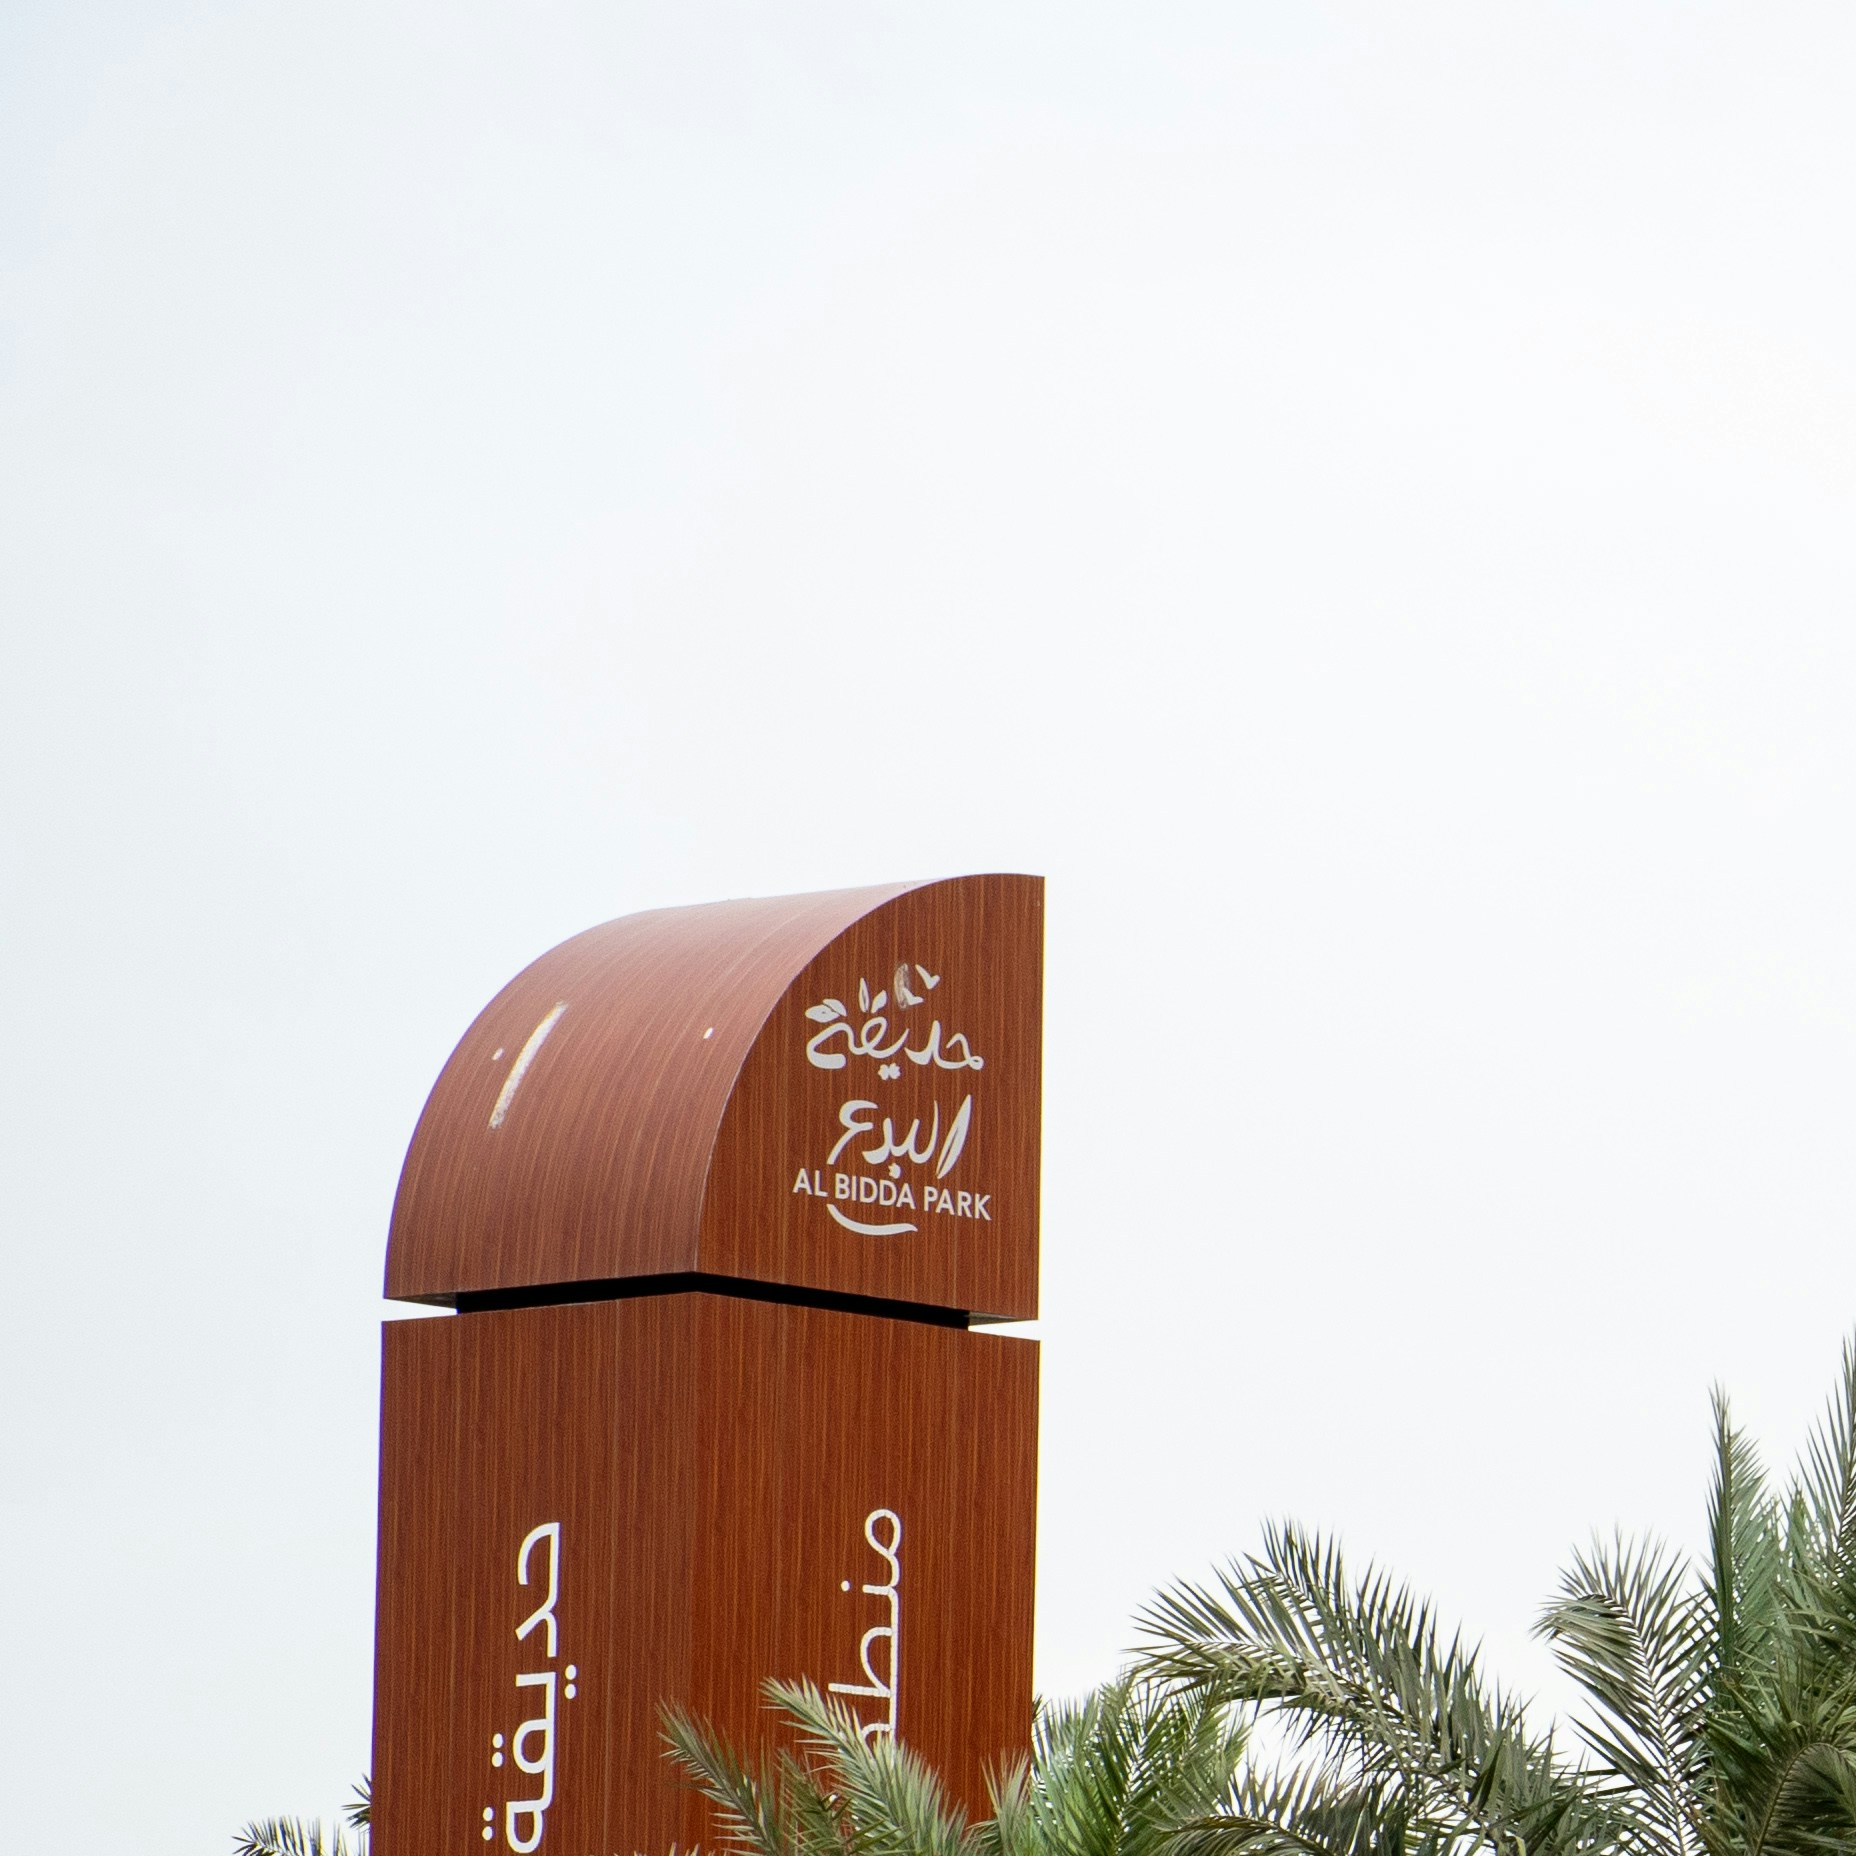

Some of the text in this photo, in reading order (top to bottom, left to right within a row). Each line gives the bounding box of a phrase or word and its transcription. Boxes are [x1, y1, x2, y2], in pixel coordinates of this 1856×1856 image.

[804, 976, 984, 1081] حديقة
[826, 1094, 972, 1180] البدع
[792, 1167, 993, 1221] AL BIDDA PARK
[482, 1522, 577, 1854] حديقة
